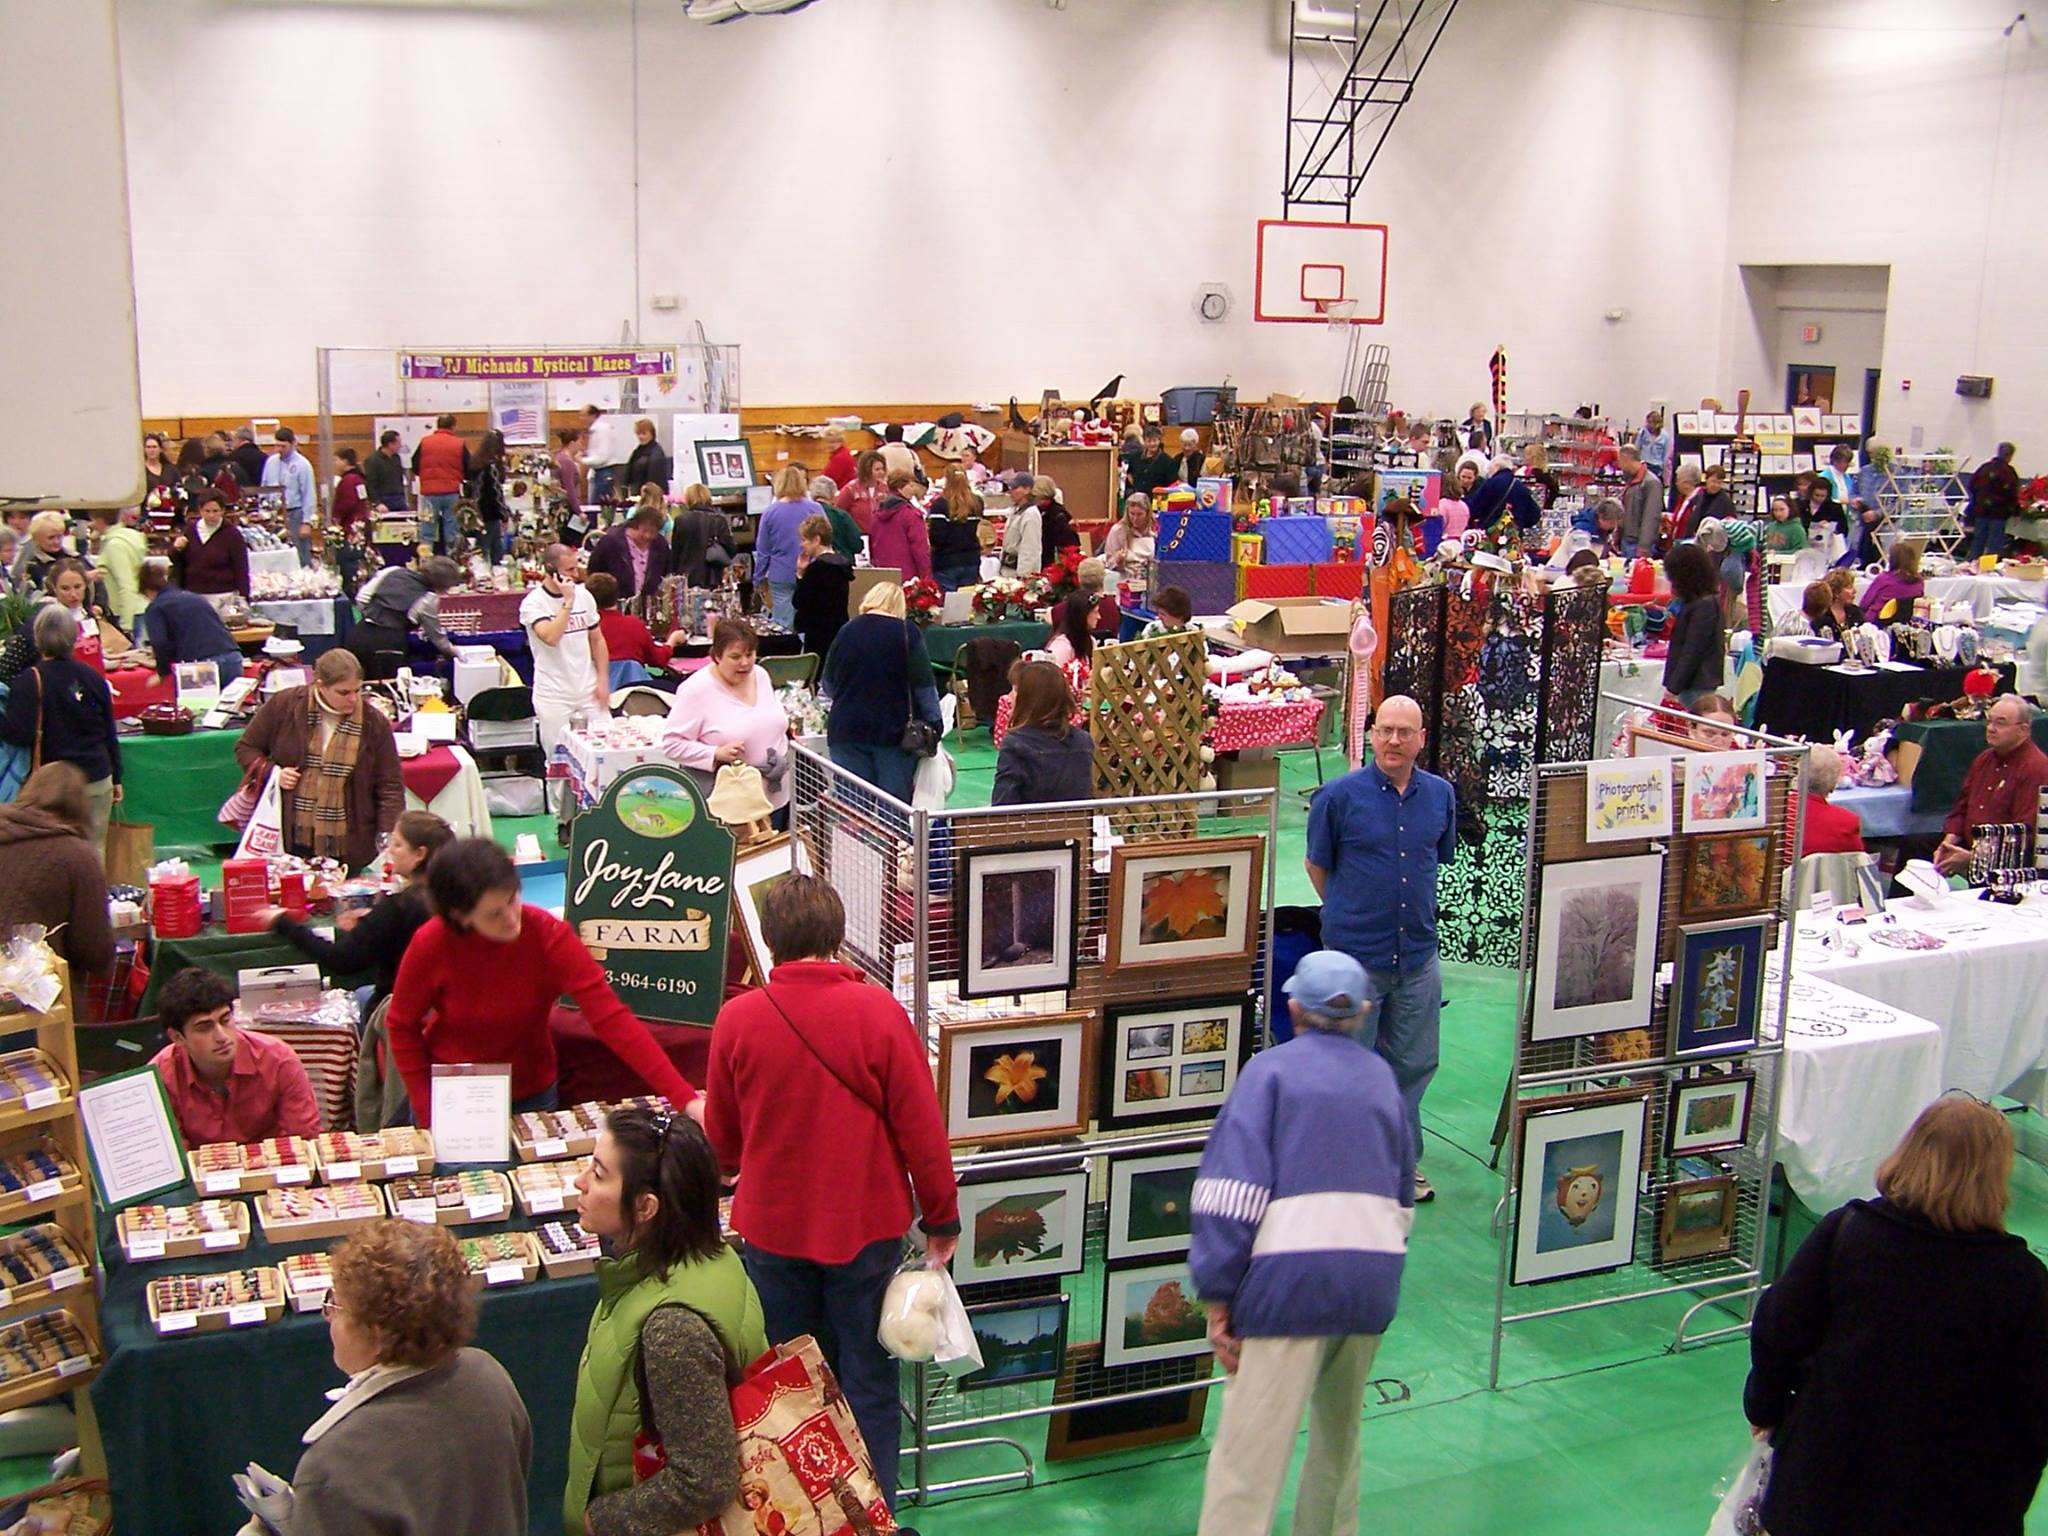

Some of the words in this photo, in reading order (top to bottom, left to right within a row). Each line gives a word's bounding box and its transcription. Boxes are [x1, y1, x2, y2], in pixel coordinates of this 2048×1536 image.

[444, 357, 461, 374] TJ
[465, 357, 528, 374] Michauds
[532, 356, 588, 377] Mystical
[592, 355, 631, 372] Mazes
[1599, 778, 1661, 801] Photographic
[1616, 803, 1645, 819] prints
[574, 839, 643, 909] Joy
[632, 851, 725, 909] Lane
[596, 925, 701, 944] FARM
[605, 969, 696, 995] 3-964-6190
